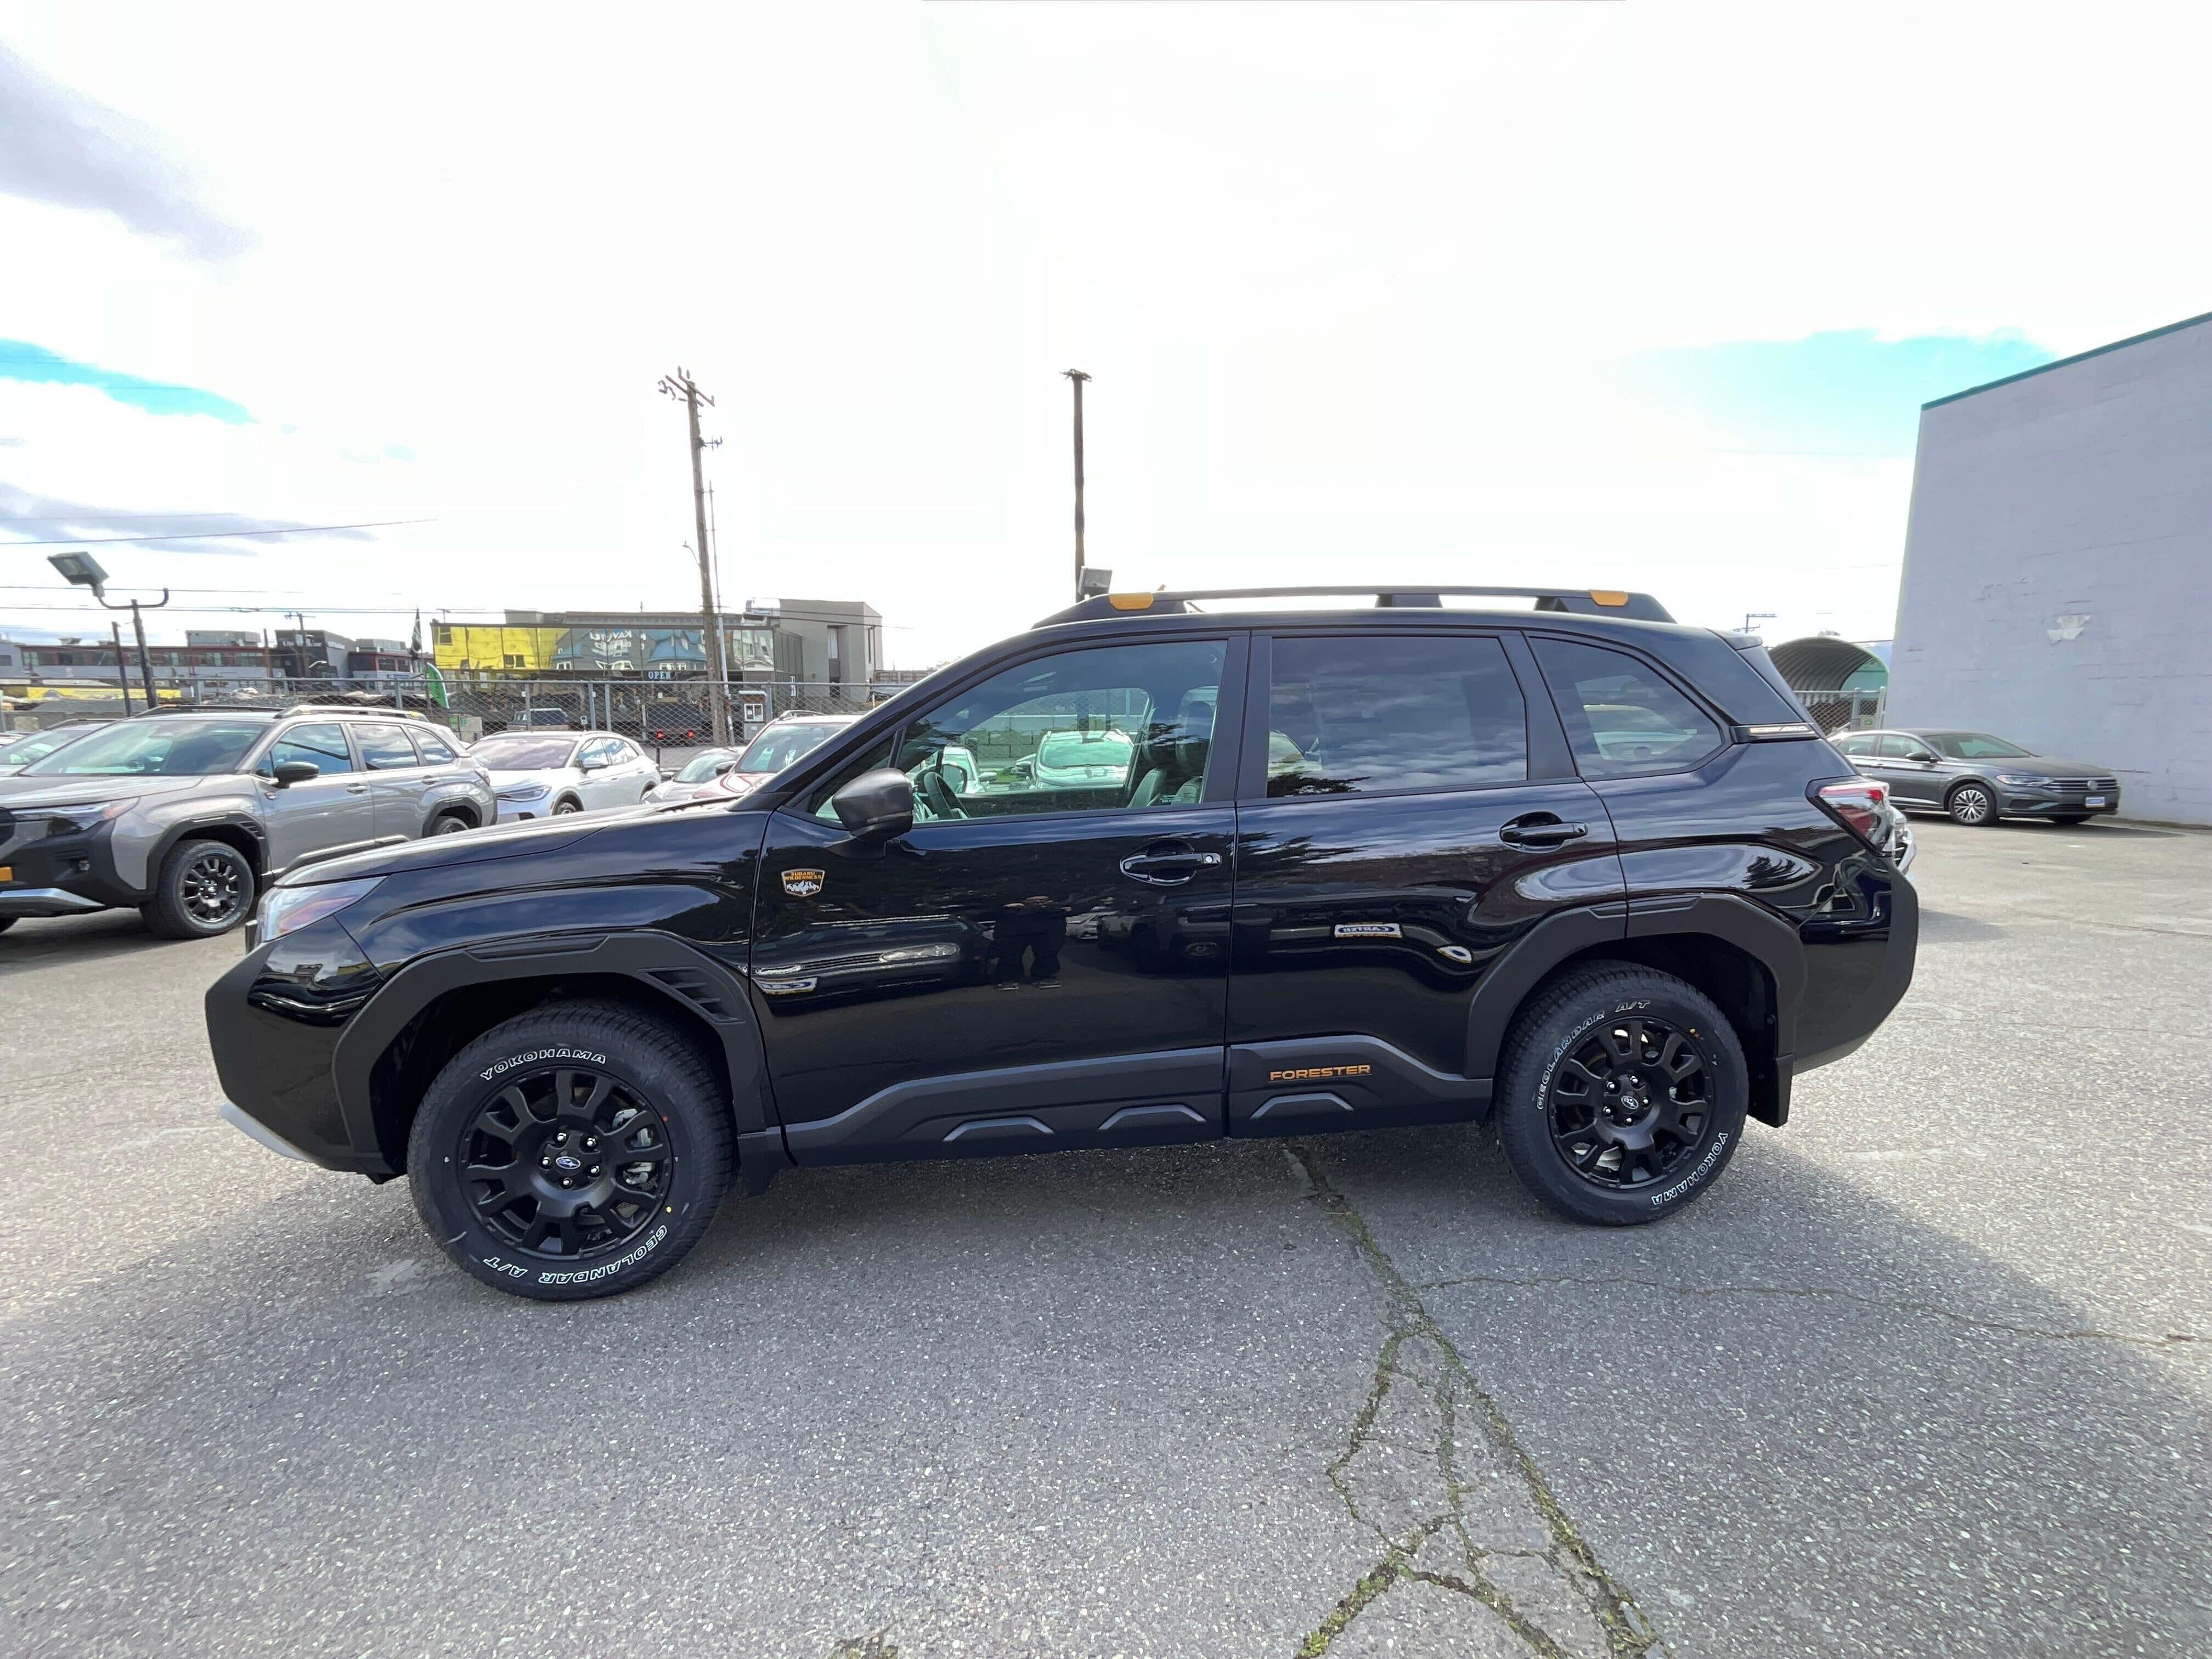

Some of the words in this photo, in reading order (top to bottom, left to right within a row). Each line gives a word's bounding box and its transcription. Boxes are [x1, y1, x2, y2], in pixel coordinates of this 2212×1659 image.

[648, 671, 671, 679] OPEN
[480, 1048, 606, 1080] YOKOHAMA
[1537, 1010, 1605, 1109] GEOLANDAR
[1615, 1000, 1650, 1013] A/T
[1270, 1064, 1371, 1081] FORESTER
[1651, 1132, 1728, 1205] YOKOHAMA
[483, 1257, 528, 1278] A/T
[538, 1225, 667, 1284] GEOLANDAR
